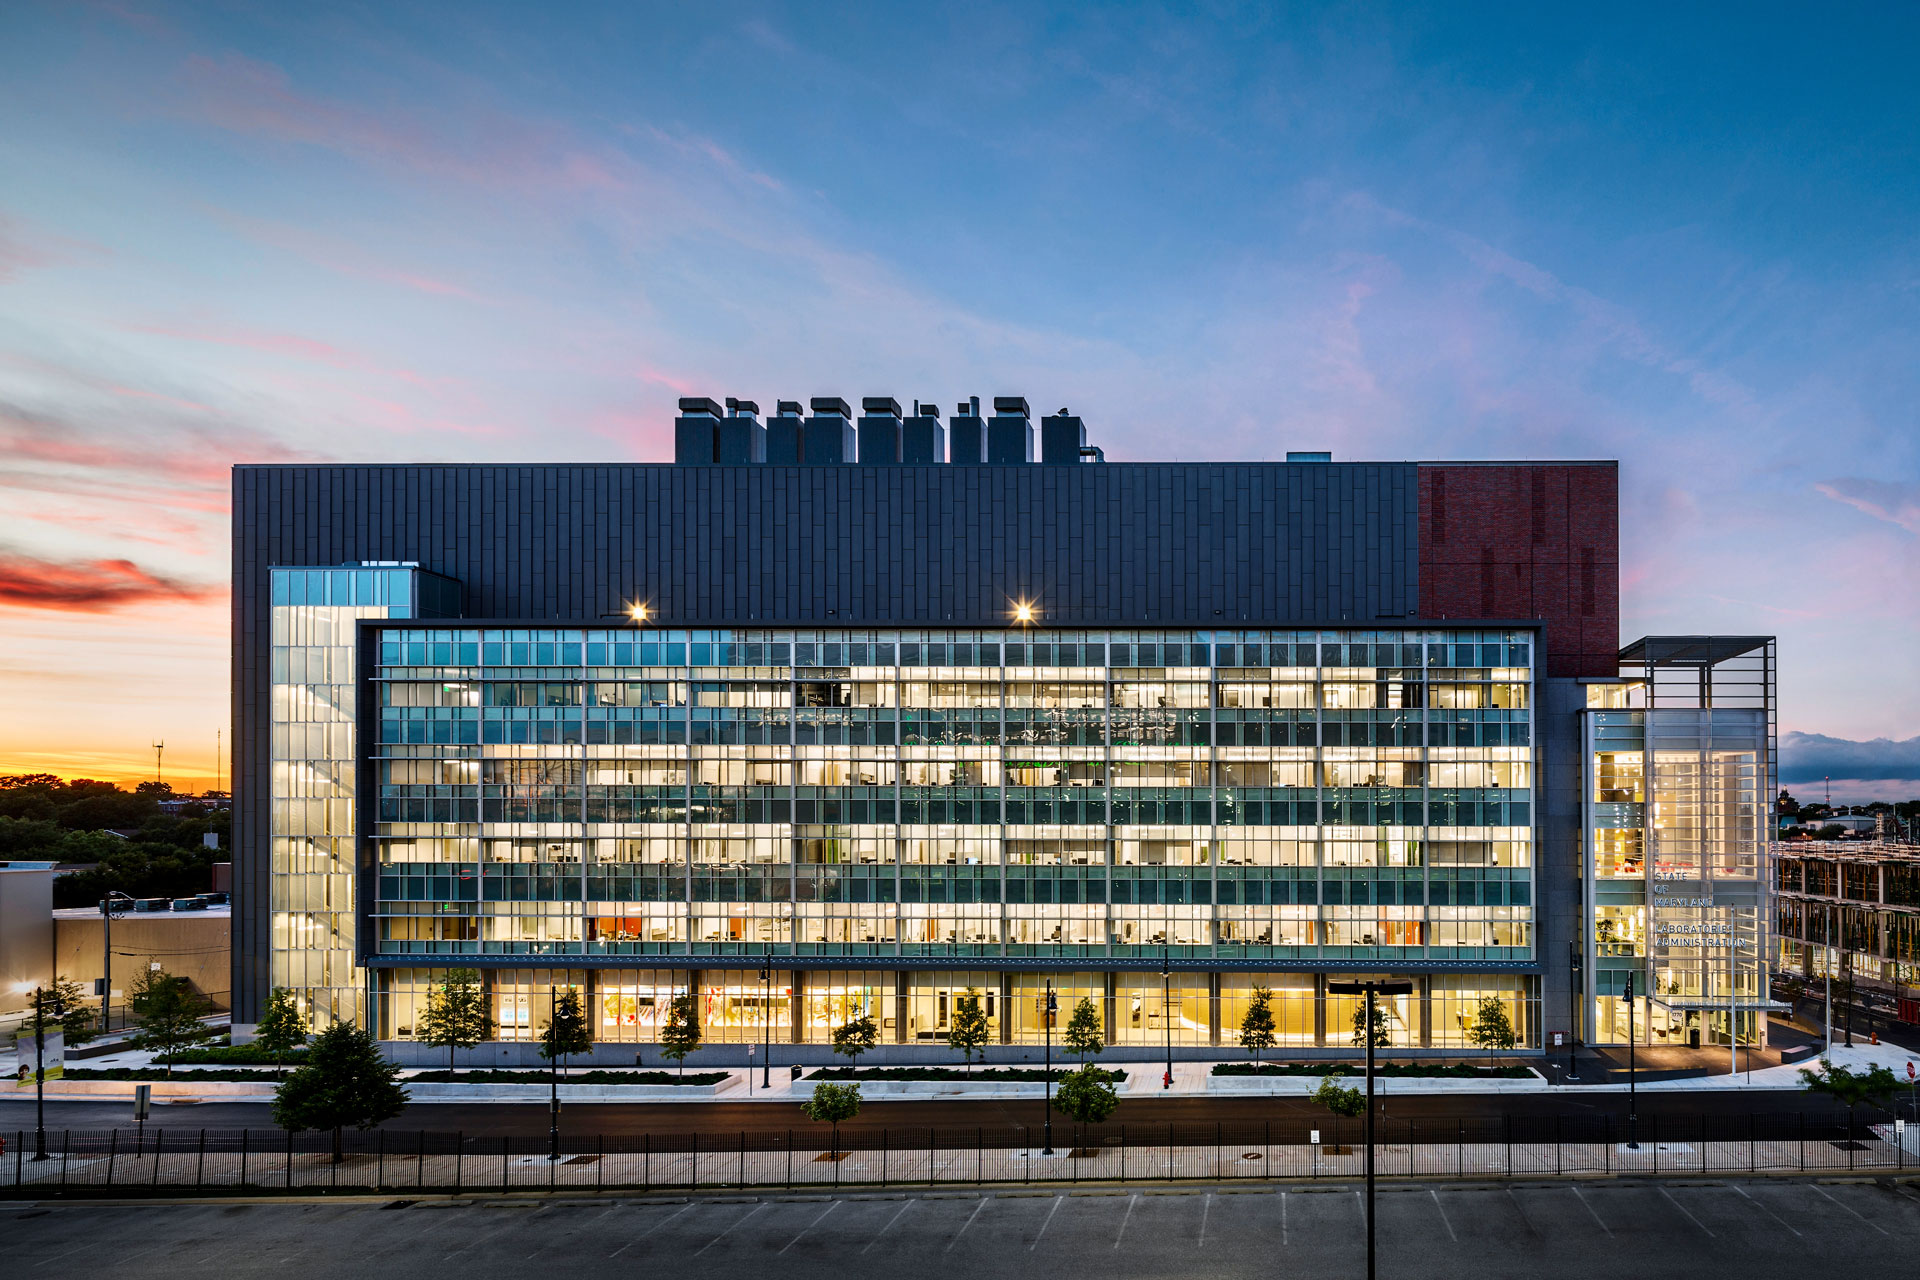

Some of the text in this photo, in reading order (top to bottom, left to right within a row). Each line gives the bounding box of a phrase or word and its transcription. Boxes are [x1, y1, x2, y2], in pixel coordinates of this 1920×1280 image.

[1655, 873, 1687, 881] STATE
[1655, 885, 1669, 894] OF
[1655, 898, 1714, 907] MARYLAND
[1655, 925, 1733, 934] LABORATORIES
[1656, 938, 1746, 947] ADMINISTRATION
